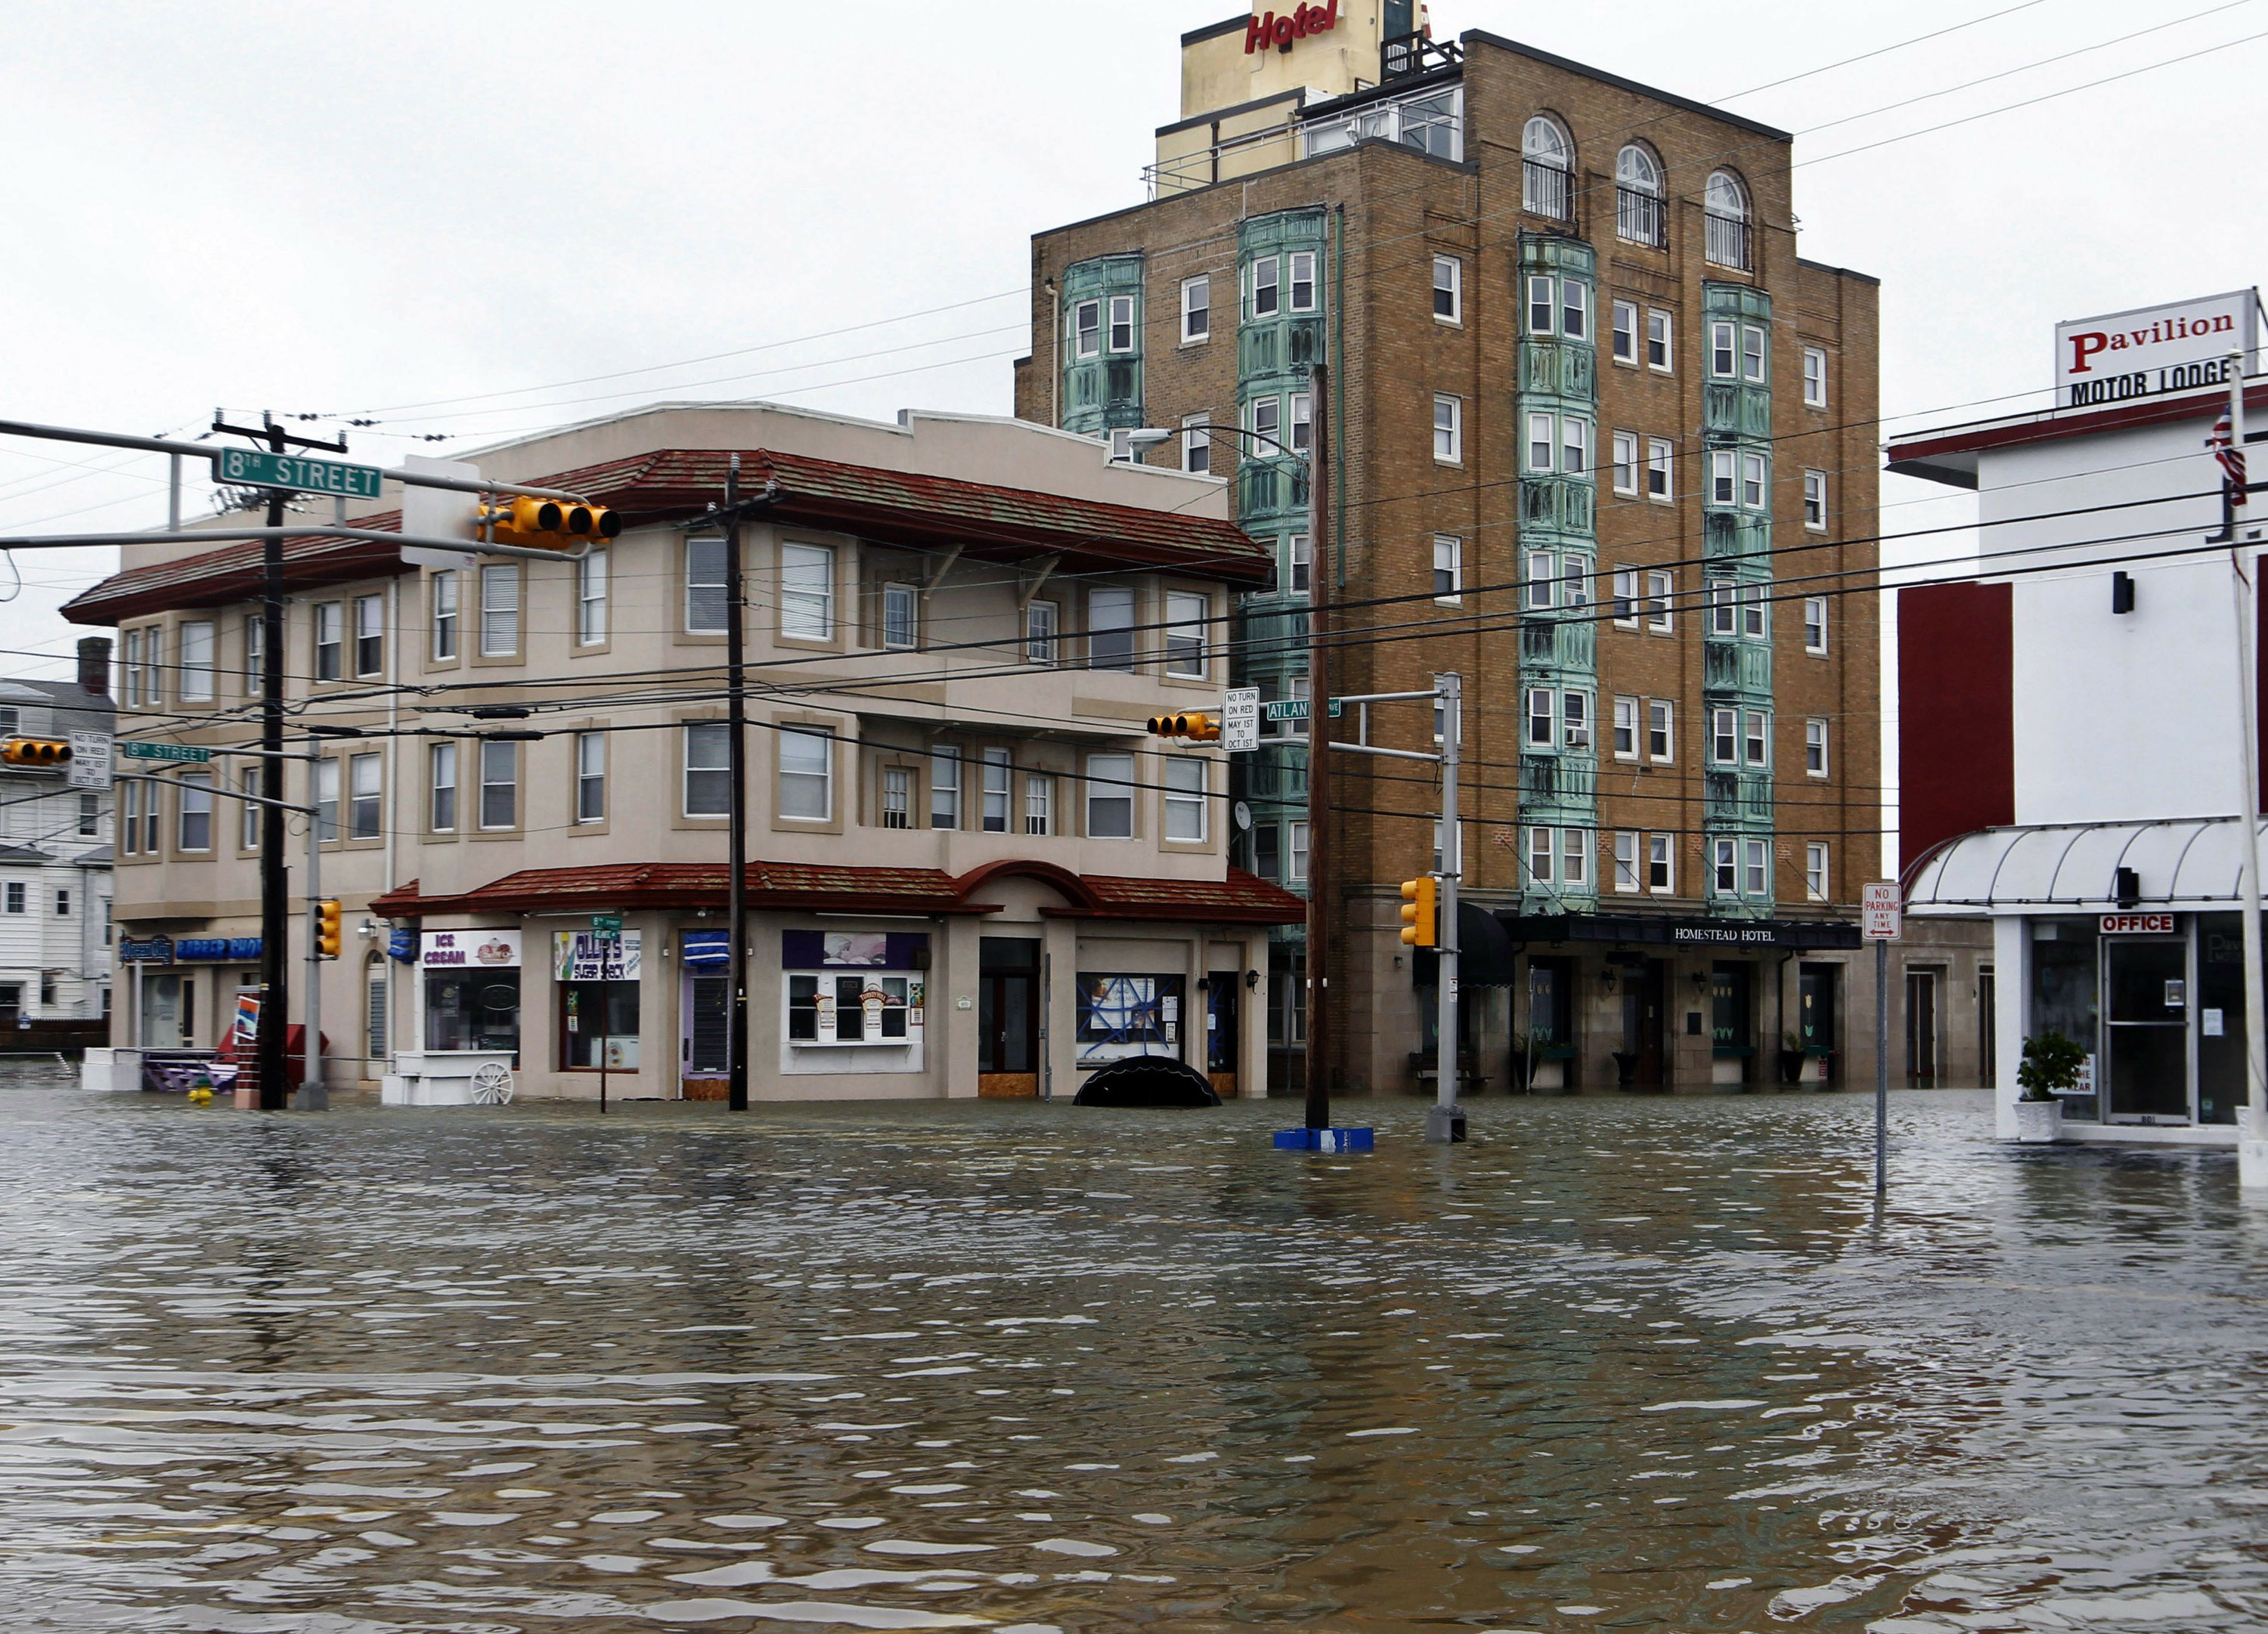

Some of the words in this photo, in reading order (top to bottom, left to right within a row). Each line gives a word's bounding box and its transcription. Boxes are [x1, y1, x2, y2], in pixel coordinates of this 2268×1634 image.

[1244, 0, 1339, 54] Hotel
[2068, 314, 2235, 373] Pavilion
[2071, 373, 2148, 406] MOTOR
[2161, 358, 2231, 392] LODGE
[228, 452, 262, 477] 8TH
[275, 458, 376, 494] STREET
[1227, 694, 1236, 702] NO
[1238, 692, 1256, 701] TURN
[1228, 706, 1238, 715] ON
[1240, 705, 1253, 713] RED
[1269, 702, 1309, 717] ATLAN
[1328, 704, 1338, 712] AVE
[1228, 720, 1241, 729] MAY
[88, 736, 109, 744] TURN
[1228, 740, 1241, 748] OCT
[91, 747, 107, 756] RED
[154, 744, 206, 762] STREET
[1875, 889, 1889, 899] NO
[1866, 901, 1898, 911] PARKING
[2103, 915, 2174, 931] OFFICE
[435, 934, 455, 948] ICE
[1675, 928, 1737, 940] HOMESTEAD
[1741, 930, 1775, 942] HOTEL
[424, 950, 466, 964] CREAM
[601, 964, 625, 979] SACK
